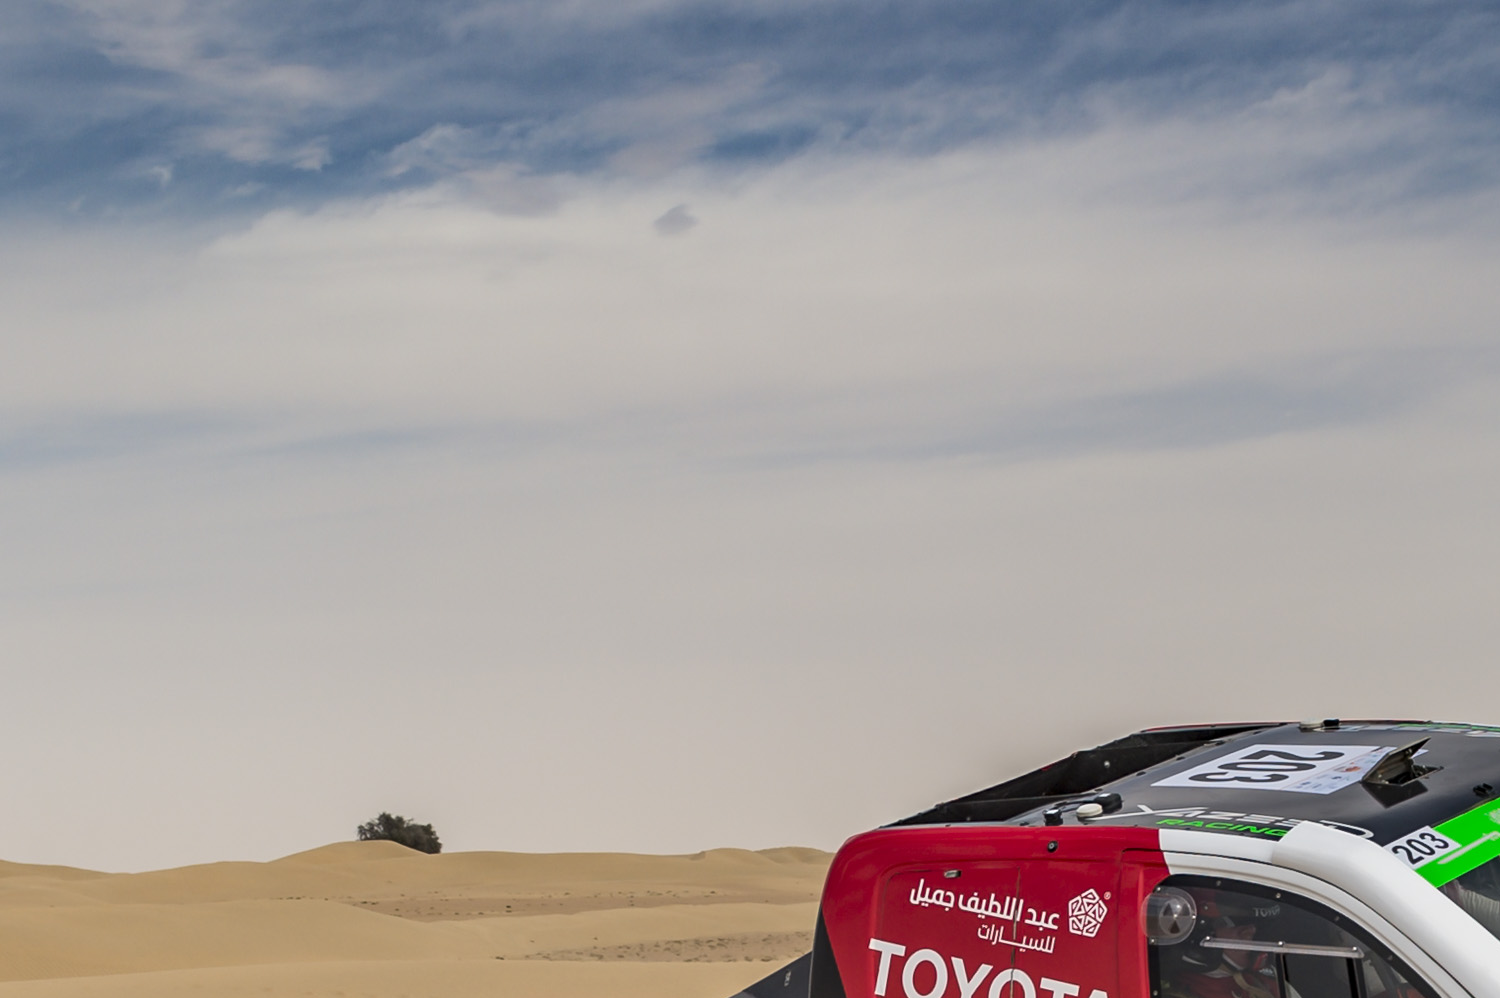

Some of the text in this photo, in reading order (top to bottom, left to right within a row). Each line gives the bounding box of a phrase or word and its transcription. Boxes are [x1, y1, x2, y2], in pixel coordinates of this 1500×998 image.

[1188, 749, 1346, 784] 203
[1156, 818, 1289, 837] RACING
[1392, 831, 1449, 865] 203
[909, 878, 1060, 931] عبد اللطيف جميل
